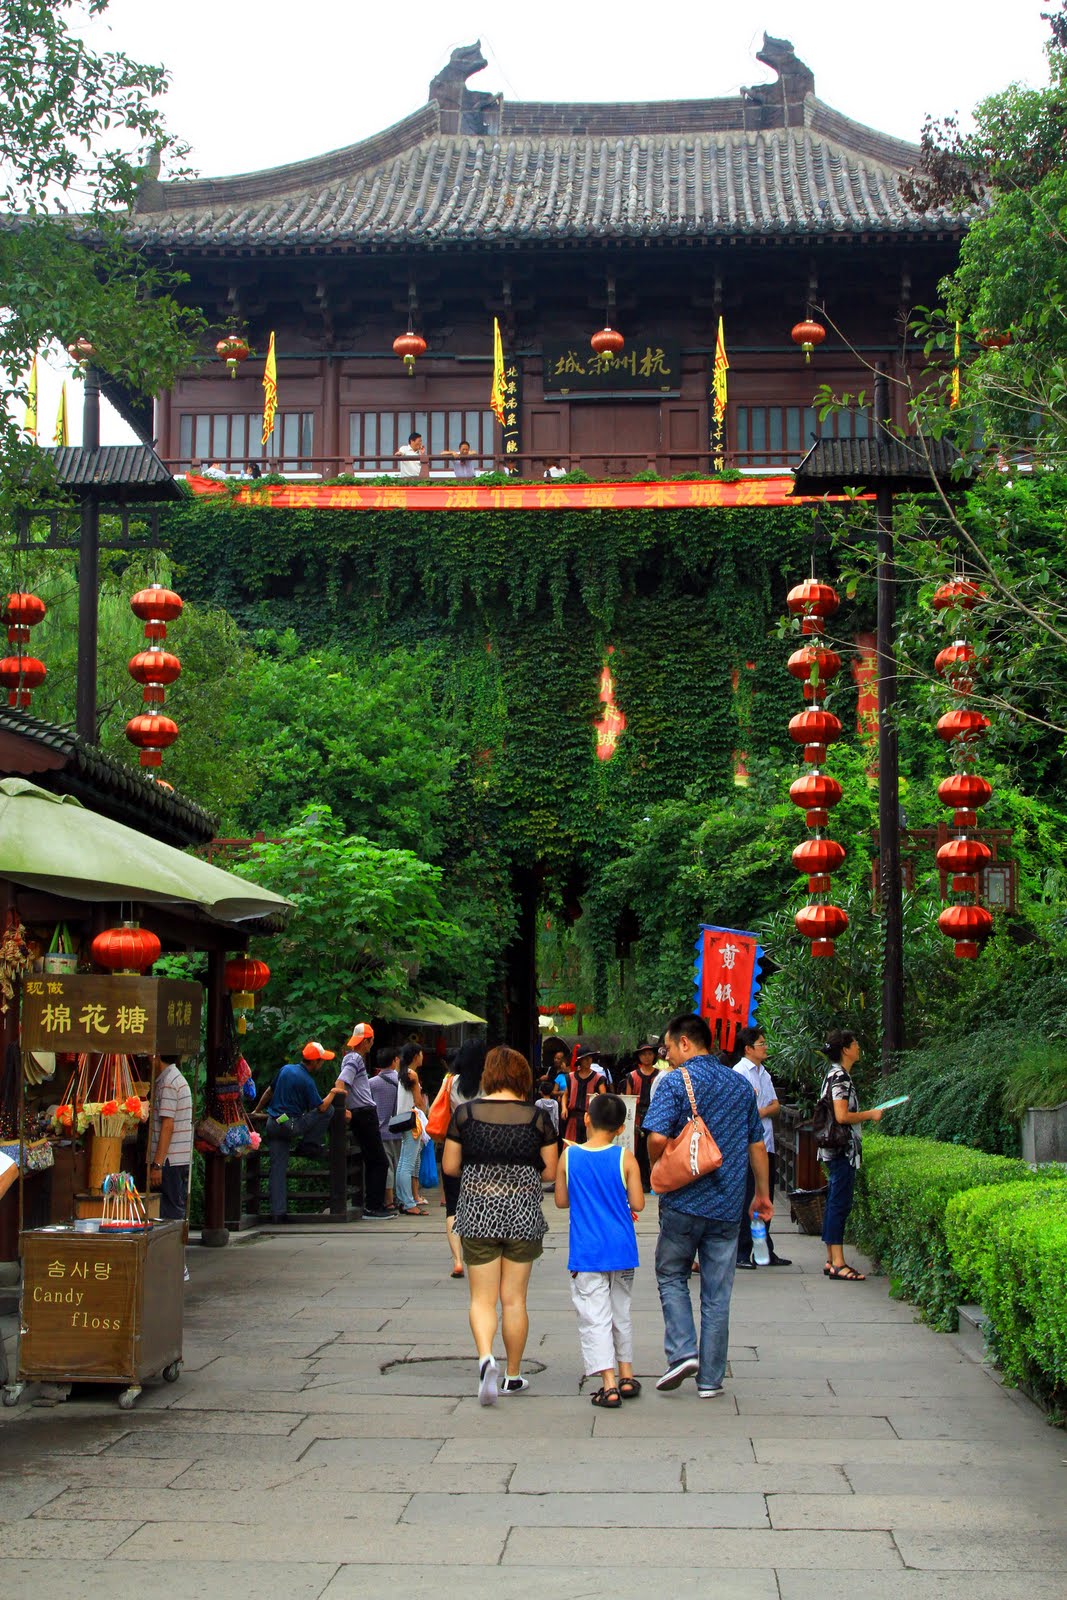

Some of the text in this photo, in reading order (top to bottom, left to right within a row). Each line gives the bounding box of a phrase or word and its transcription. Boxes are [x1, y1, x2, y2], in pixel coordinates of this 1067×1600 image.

[504, 366, 519, 474] 北宋南宋一脉
[26, 981, 64, 995] 现做
[40, 1003, 149, 1034] 棉花糖
[47, 1260, 112, 1281] 솜사탕
[33, 1286, 84, 1306] Candy
[71, 1311, 121, 1331] floss
